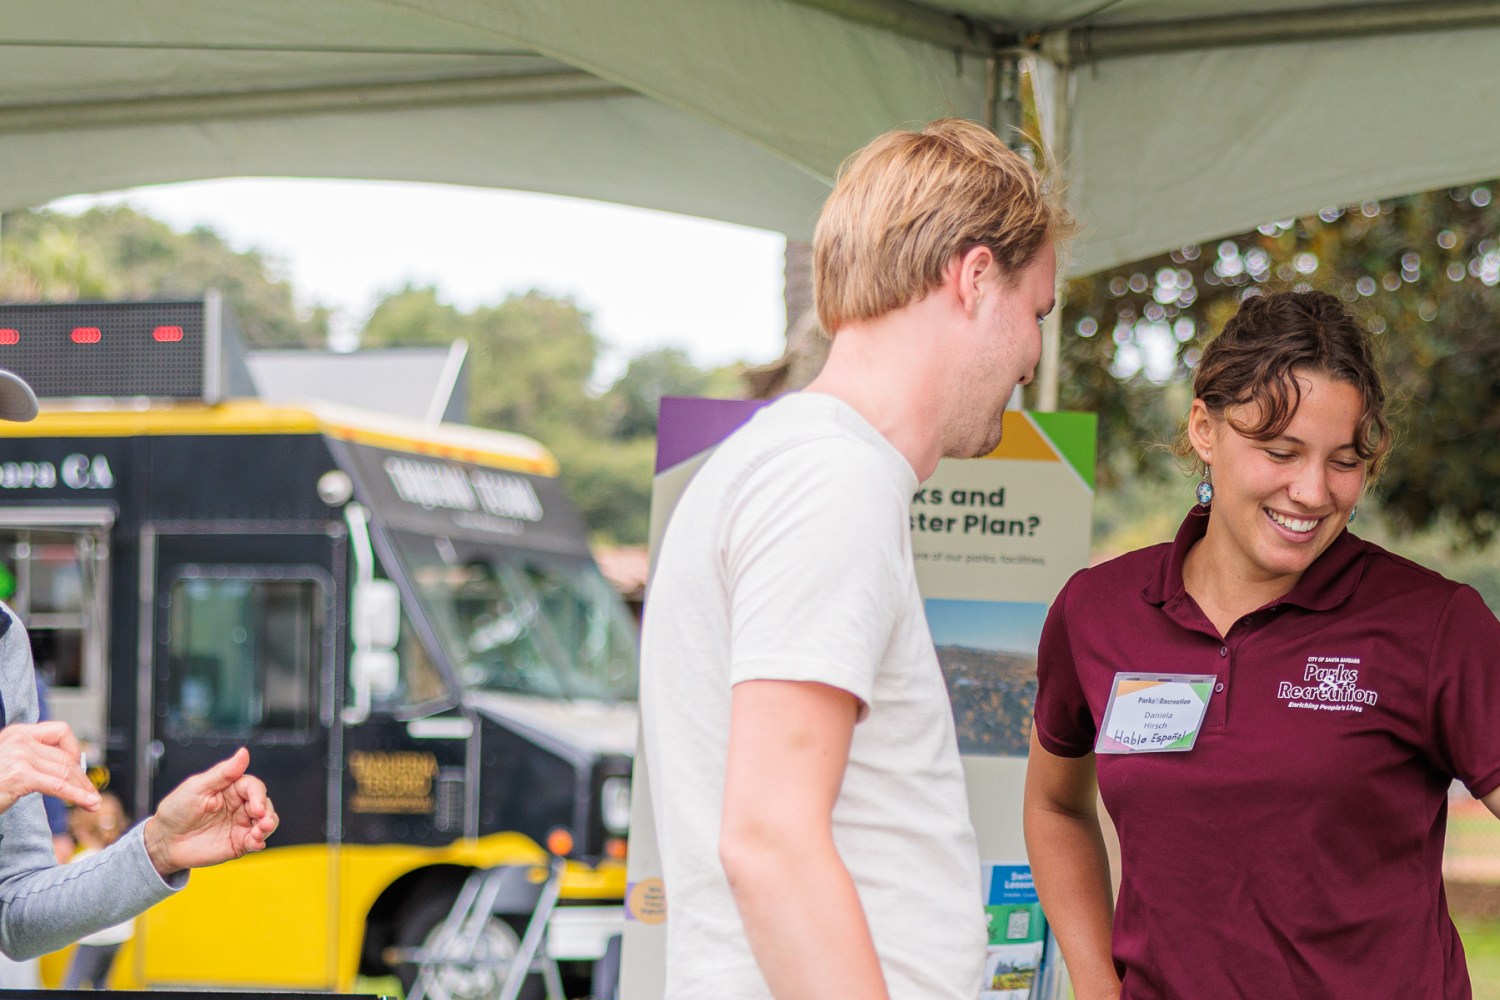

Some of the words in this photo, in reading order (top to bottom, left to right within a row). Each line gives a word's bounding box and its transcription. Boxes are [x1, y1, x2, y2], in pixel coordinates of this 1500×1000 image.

[62, 452, 114, 489] CA
[951, 488, 1005, 507] and
[963, 514, 1040, 536] Plan?
[1304, 664, 1358, 683] Parks
[1278, 681, 1378, 705] Recreation
[1318, 675, 1348, 692] &
[1288, 702, 1319, 711] Enriching
[1319, 704, 1345, 712] People's
[1346, 704, 1363, 713] Lives
[1113, 730, 1147, 746] Hablo
[1151, 730, 1186, 745] Español
